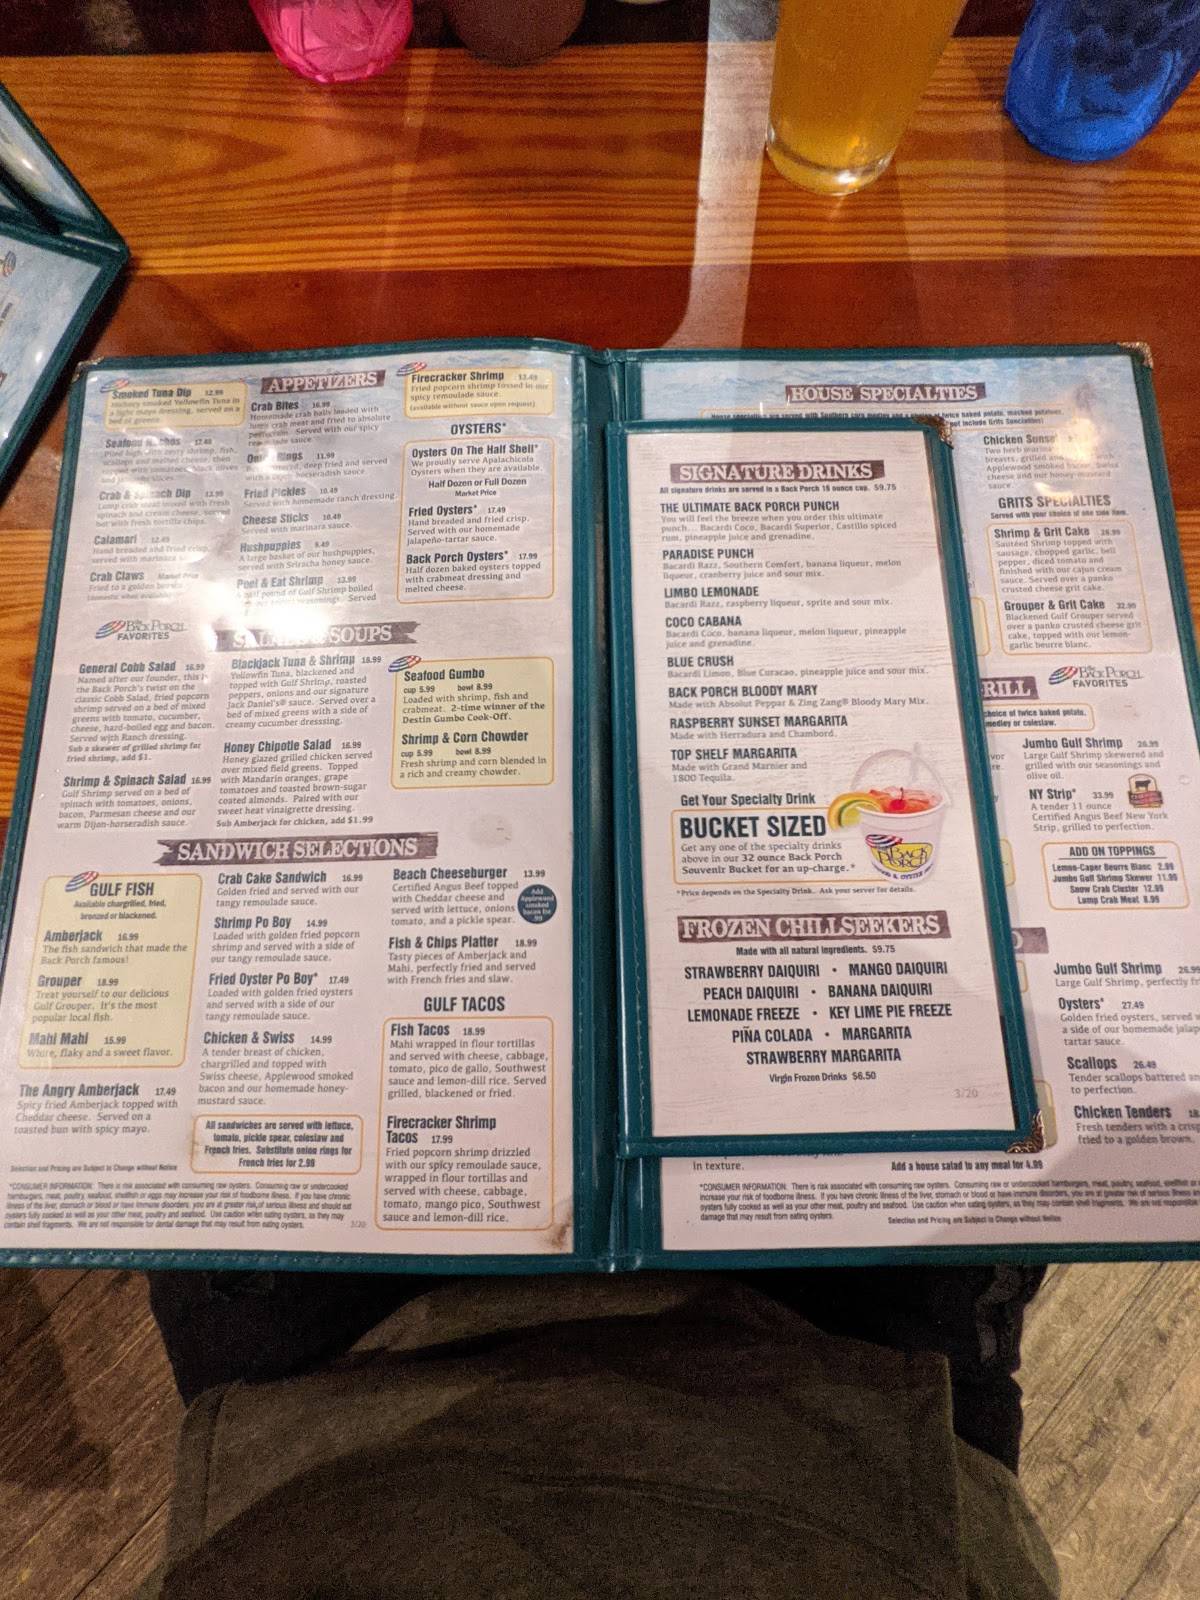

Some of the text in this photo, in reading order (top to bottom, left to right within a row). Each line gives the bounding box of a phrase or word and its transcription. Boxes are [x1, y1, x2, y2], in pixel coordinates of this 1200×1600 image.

[269, 371, 378, 391] APPETIZERS
[411, 372, 504, 382] Firecracker Shrimp
[791, 384, 977, 402] HOUSE SPECIALTIES
[412, 448, 448, 459] Oysters
[451, 447, 463, 455] On
[467, 446, 483, 455] The
[487, 445, 506, 454] Half
[680, 463, 872, 480] SIGNATURE DRINKS
[429, 480, 446, 488] Half
[485, 478, 499, 486] Full
[660, 501, 839, 513] THE ULTIMATE BACK PORCH PUNCH
[998, 495, 1111, 508] GRITS SPECIALTIES
[409, 506, 433, 517] Fried
[242, 512, 309, 525] Cheese Sticks
[432, 517, 464, 525] breaded
[467, 516, 481, 524] and
[485, 515, 504, 523] fried
[506, 515, 529, 525] crisp.
[406, 554, 431, 564] Back
[434, 552, 463, 563] Porch
[1004, 599, 1105, 611] Grouper & Grit Cake
[666, 616, 742, 628] COCO CABANA
[330, 625, 392, 642] SOUPS
[667, 656, 734, 667] BLUE CRUSH
[404, 669, 484, 681] Seafood Gumbo
[419, 685, 435, 693] 5.99
[982, 682, 1030, 697] RILL
[670, 715, 847, 728] RASPBERRY SUNSET MARGARITA
[402, 731, 528, 745] Shrimp & Corn Chowder
[224, 739, 331, 753] Honey Chipotle Salad
[64, 773, 186, 787] Shrimp & Spinach Salad
[681, 793, 816, 807] Get Your Specialty Drink
[1029, 789, 1043, 800] NY
[680, 816, 826, 838] BUCKET SIZED
[178, 837, 417, 859] SANDWICH SELECTIONS
[1070, 846, 1155, 856] ADD ON TOPPINGS
[393, 868, 545, 880] Beach Cheeseburger 13.99
[682, 866, 726, 874] Souvenir
[729, 865, 762, 873] Bucket
[765, 865, 780, 873] for
[218, 871, 363, 885] Crab Cake Sandwich 16.99
[90, 882, 154, 896] GULF FISH
[682, 915, 940, 938] FROZEN CHILLSEEKERS
[44, 930, 139, 942] Amberjack 16.99
[685, 962, 947, 979] STRAWBERRY DAIQUIRI MANGO DAIQUIRI
[38, 975, 119, 988] Grouper 18.99
[424, 996, 505, 1012] GULF TACOS
[1122, 1001, 1144, 1009] 27.49
[688, 1004, 952, 1022] LEMONADE FREEZE KEY LIME PIE FREEZE
[391, 1023, 485, 1036] Fish Tacos 18.99
[732, 1026, 912, 1043] PIÑA COLADA MARGARITA
[204, 1031, 332, 1044] Chicken & Swiss 14.99
[390, 1039, 535, 1050] Mahi wrapped in flour tortillas
[1067, 1057, 1117, 1070] Scallops
[770, 1071, 876, 1084] Virgin Frozen Drinks $6.50
[20, 1083, 176, 1098] The Angry Amberjack 17.49
[1074, 1105, 1172, 1118] Chicken Tenders
[387, 1116, 496, 1131] Firecracker Shrimp
[383, 1214, 410, 1222] sauce
[412, 1212, 430, 1222] and
[434, 1210, 483, 1222] lemon-dill
